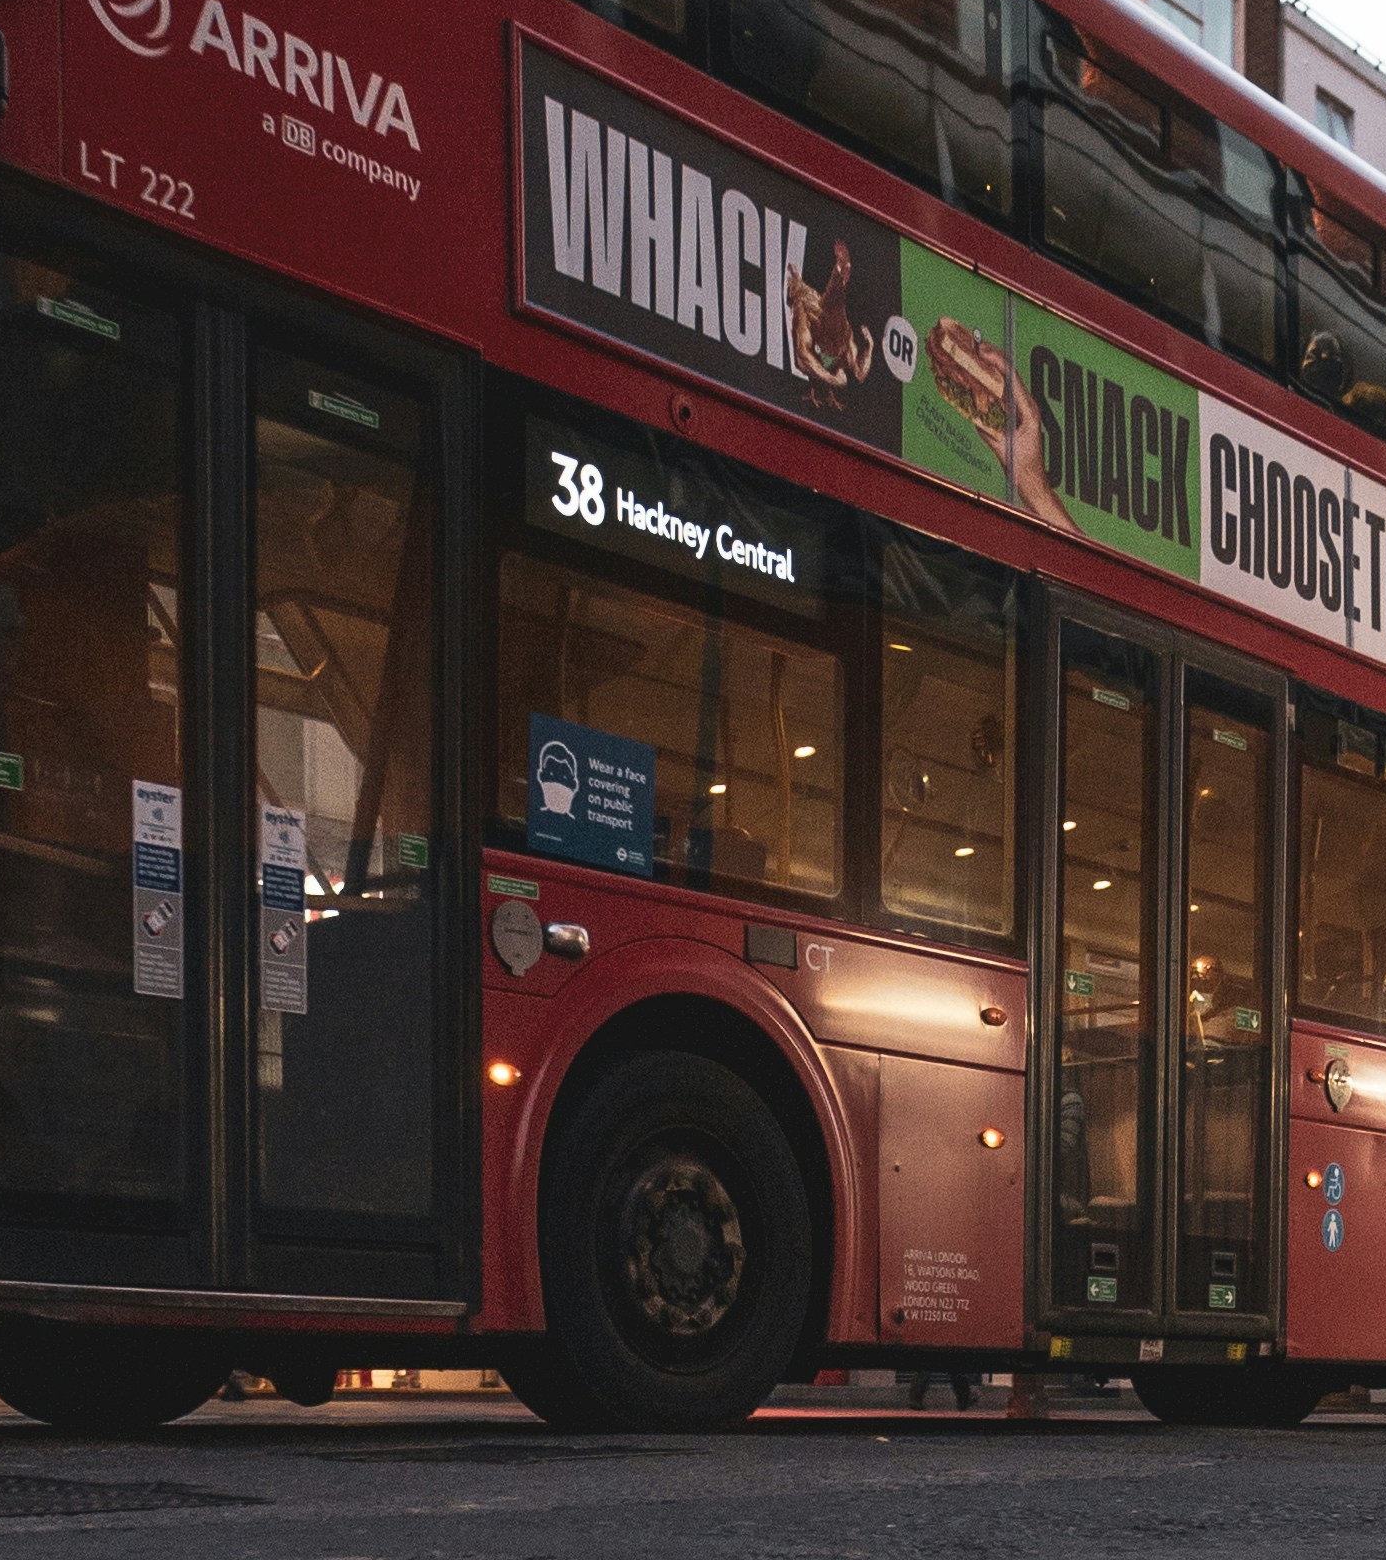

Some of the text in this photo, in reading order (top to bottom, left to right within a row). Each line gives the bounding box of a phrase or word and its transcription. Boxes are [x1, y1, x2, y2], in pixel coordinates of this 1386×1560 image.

[263, 112, 421, 202] a DB company
[80, 140, 196, 220] LT 222
[544, 94, 810, 382] WHACK
[889, 328, 914, 367] OR
[1029, 344, 1192, 550] SNACK
[551, 451, 796, 584] 38 Hackney Central
[1209, 432, 1361, 623] CHOOSE
[589, 757, 647, 785] Wear a face
[589, 776, 631, 800] covering
[588, 793, 634, 815] on public
[588, 809, 634, 832] transport
[805, 942, 835, 973] CT
[903, 1248, 968, 1264] ARRIVA LONDON
[903, 1280, 931, 1293] WOOD
[903, 1295, 939, 1309] LONDON
